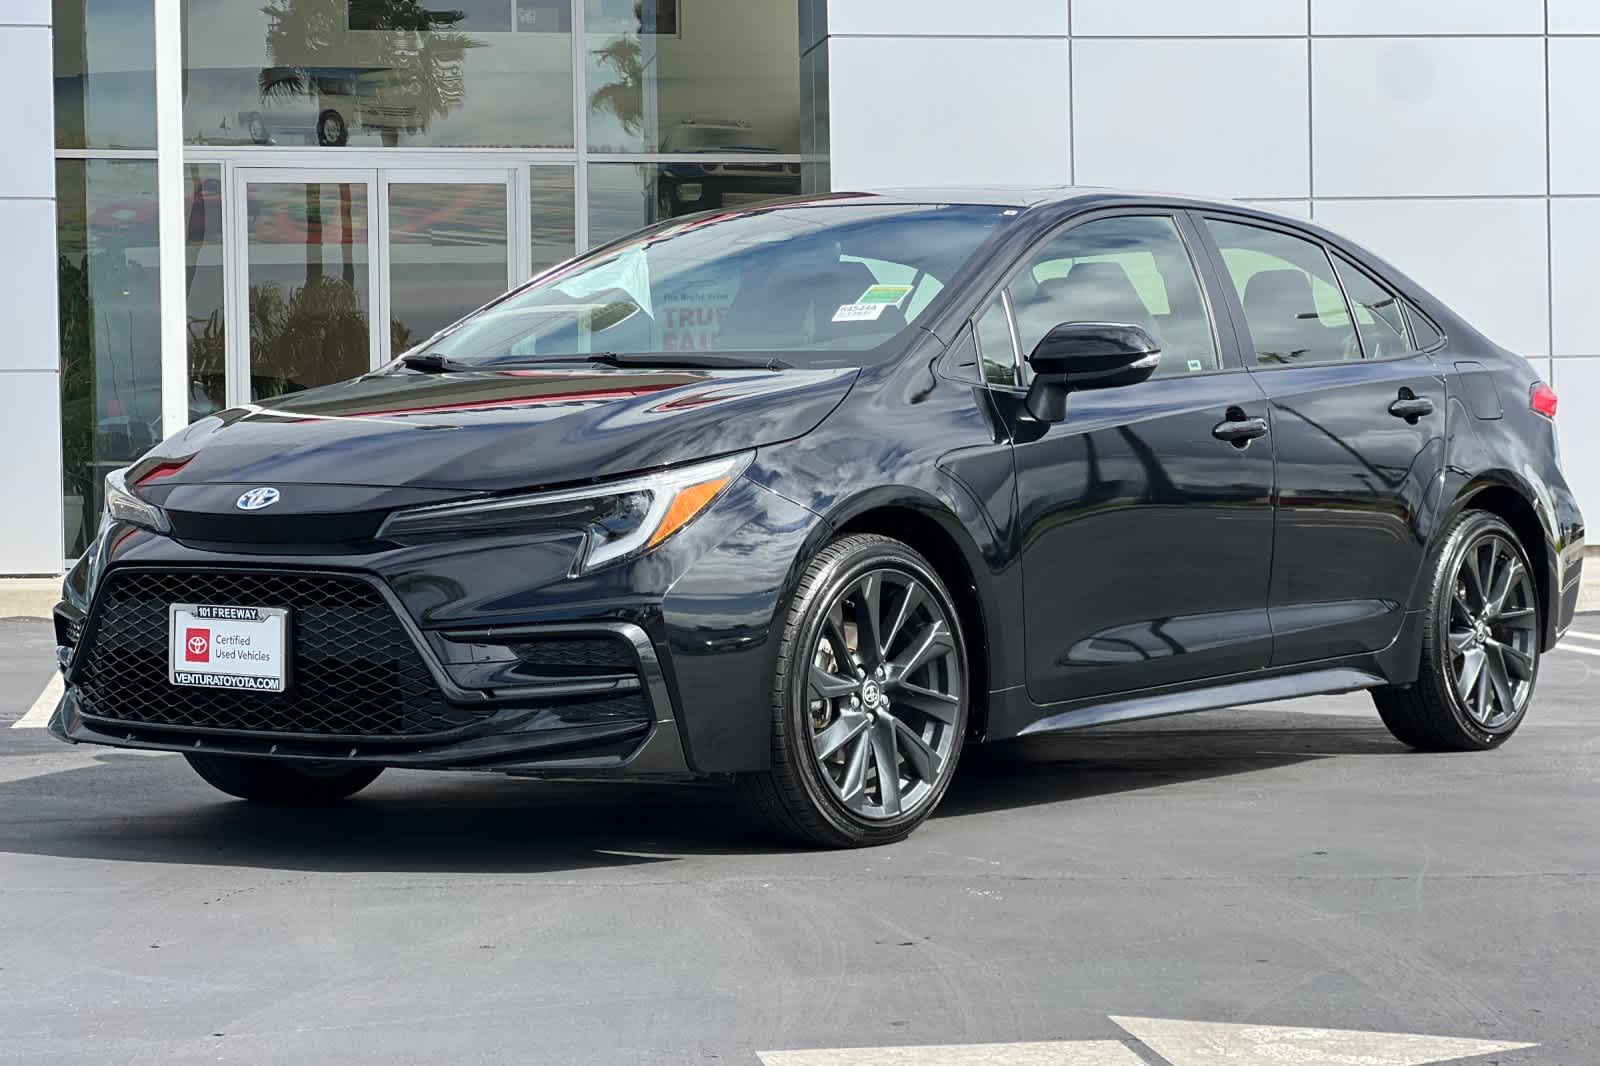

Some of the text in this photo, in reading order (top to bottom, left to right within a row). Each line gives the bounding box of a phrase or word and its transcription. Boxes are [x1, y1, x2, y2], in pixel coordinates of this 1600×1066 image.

[199, 607, 257, 619] 101 FREEWAY
[215, 634, 251, 646] Certified
[215, 649, 271, 662] Used Vehicles
[176, 673, 279, 689] VENTURATOYOTA.COM
